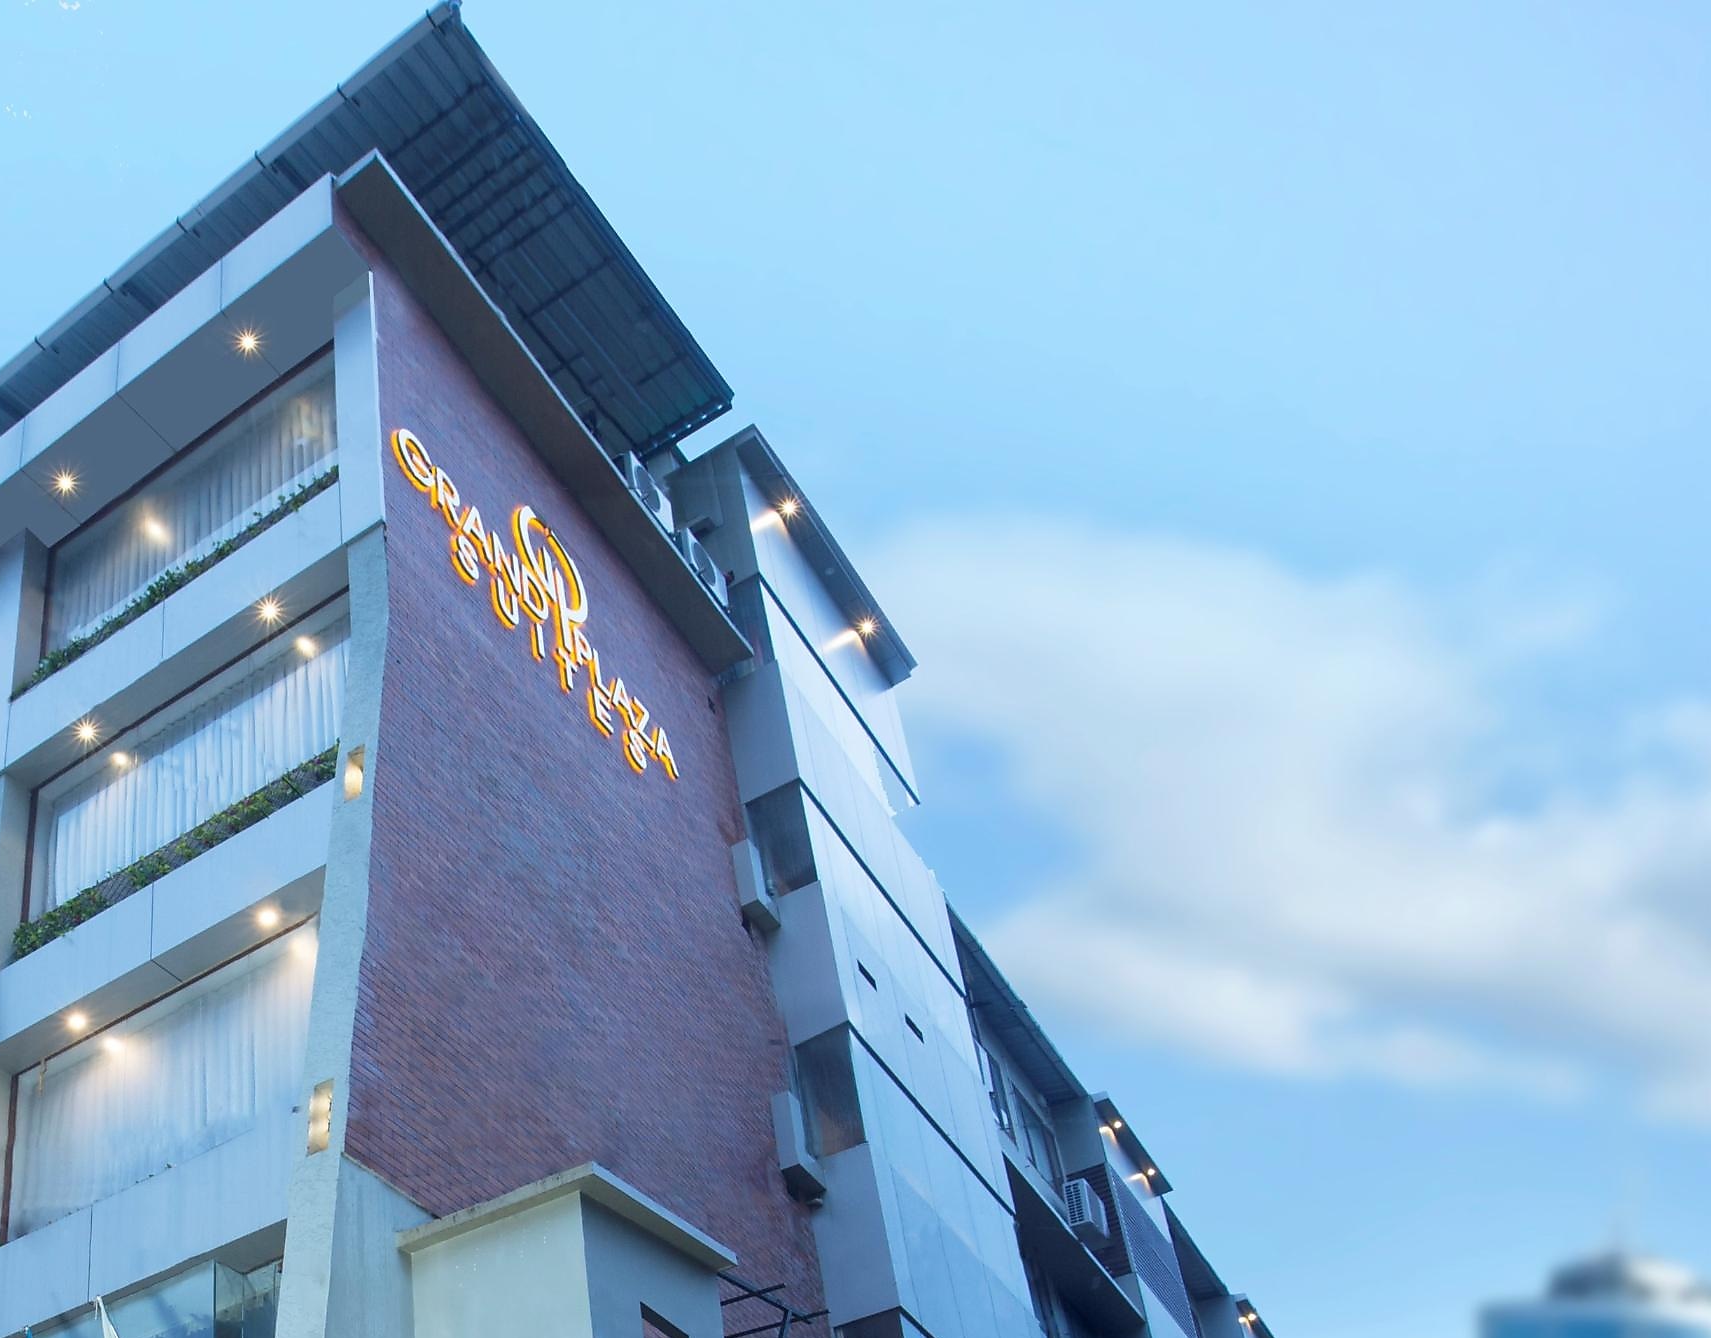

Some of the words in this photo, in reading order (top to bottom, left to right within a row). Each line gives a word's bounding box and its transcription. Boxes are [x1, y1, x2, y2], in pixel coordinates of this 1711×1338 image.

[391, 428, 551, 626] GRAND
[450, 532, 649, 775] SUITES
[569, 626, 681, 782] PLAZA
